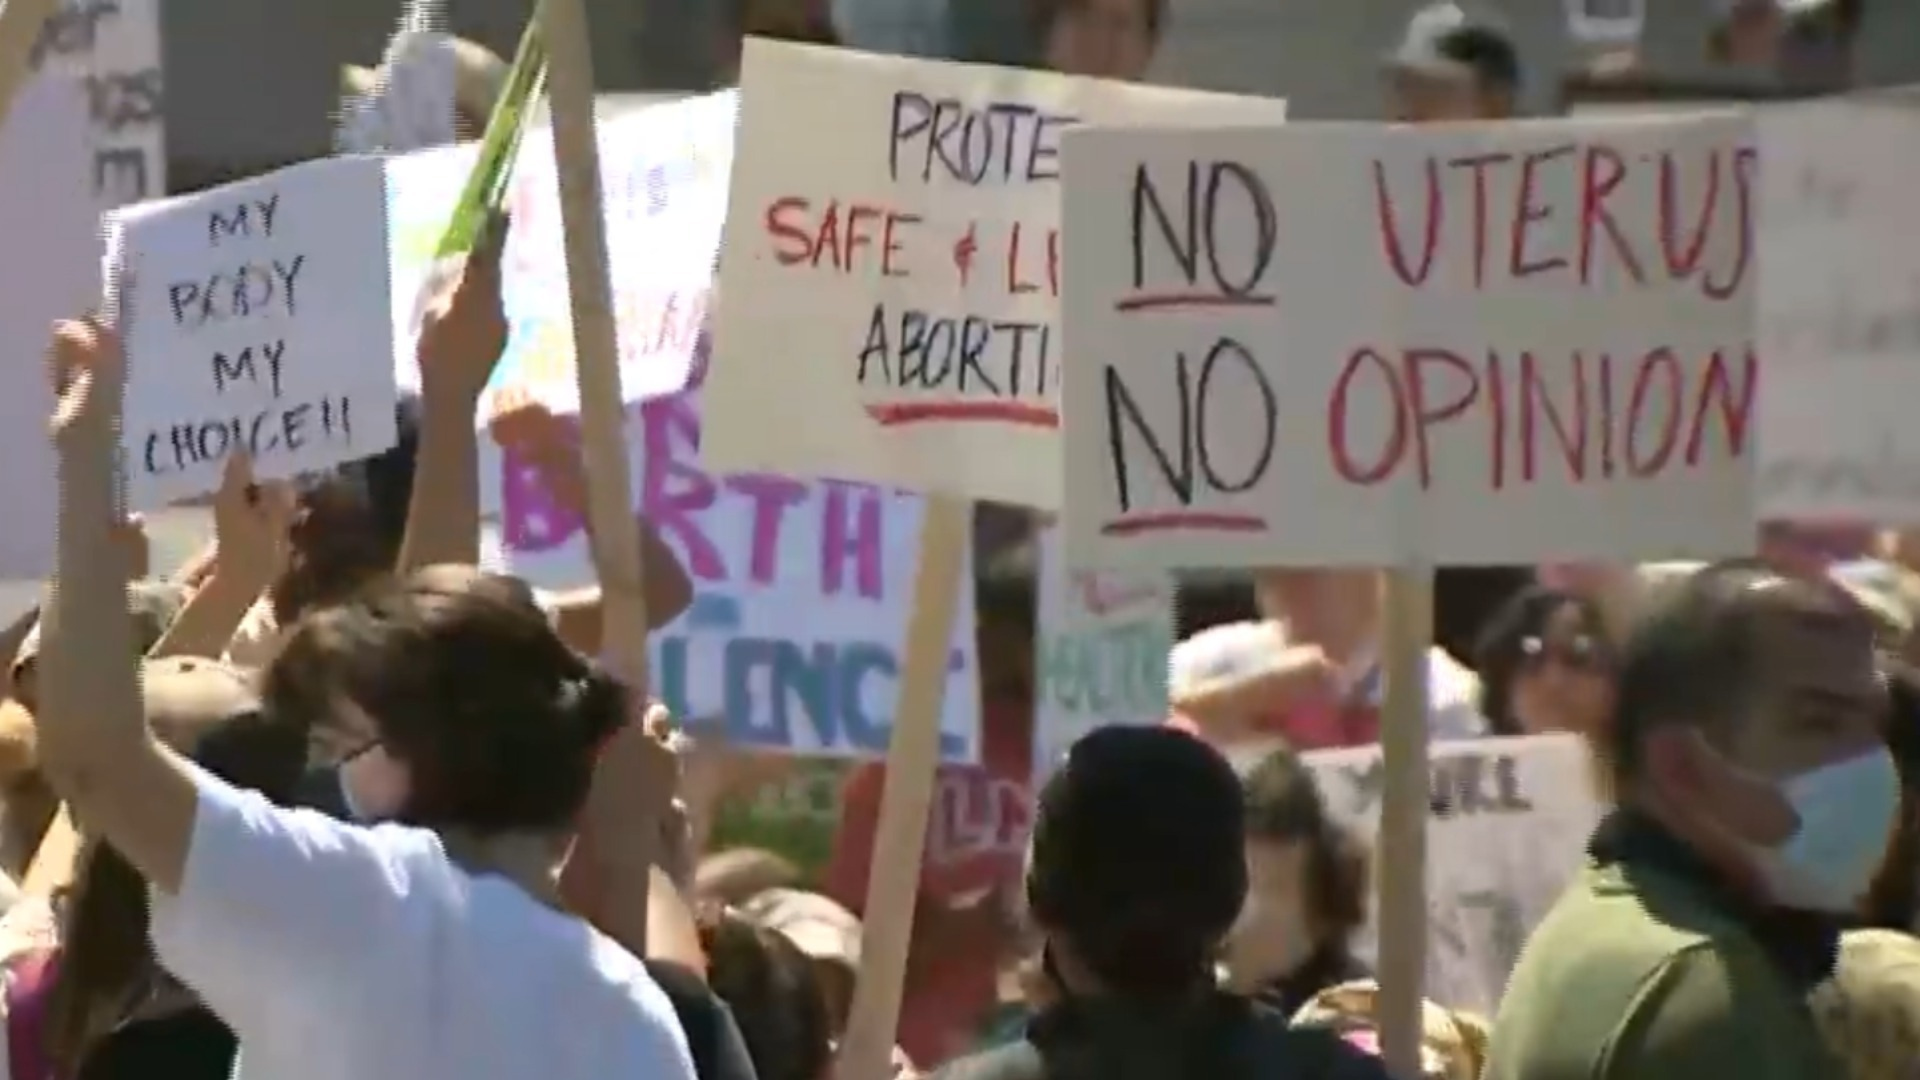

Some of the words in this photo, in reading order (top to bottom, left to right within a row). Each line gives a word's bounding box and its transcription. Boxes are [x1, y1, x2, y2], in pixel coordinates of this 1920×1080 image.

[208, 193, 280, 247] MY
[764, 196, 923, 277] SAFE
[1131, 158, 1277, 299] NO
[1374, 146, 1757, 300] UTERUS
[212, 338, 286, 398] MY
[856, 302, 1059, 397] ABORTI
[1105, 336, 1277, 513] NO
[1328, 344, 1758, 493] OPINION
[502, 393, 884, 600] BRTH
